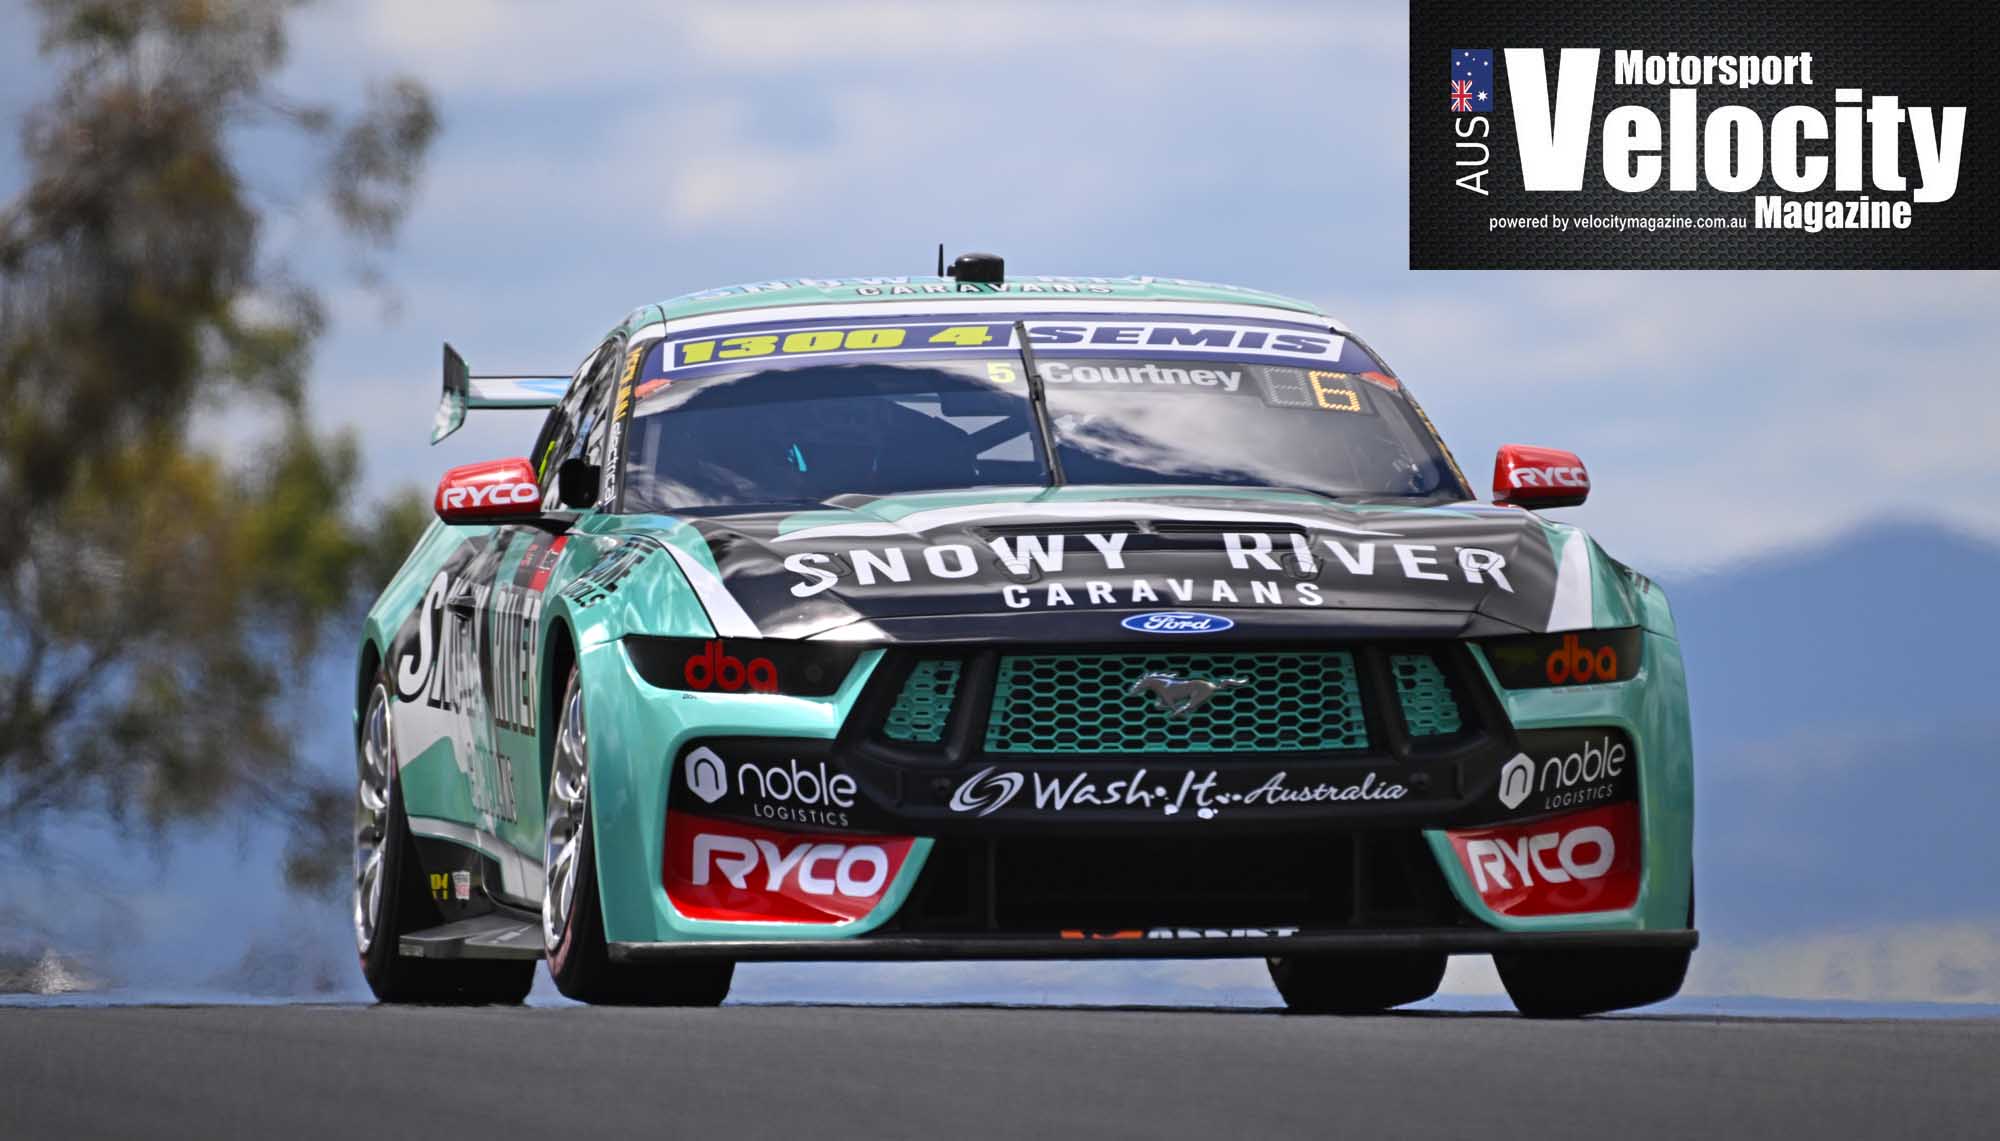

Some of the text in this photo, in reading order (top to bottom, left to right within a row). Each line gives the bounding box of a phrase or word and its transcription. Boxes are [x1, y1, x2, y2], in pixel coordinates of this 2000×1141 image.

[856, 282, 1113, 295] CARAVANS
[682, 325, 1331, 364] 1300 4 SEMIS
[988, 362, 1241, 391] 5 Courtney
[442, 482, 540, 511] RYCO
[784, 532, 1515, 597] SNOWY RIVER
[1002, 579, 1324, 609] CARAVANS
[1143, 613, 1210, 631] Ford
[684, 640, 778, 693] dba
[1546, 634, 1617, 685] dba
[1540, 736, 1627, 792] noble
[738, 759, 857, 808] noble
[1244, 771, 1408, 803] Australia
[1545, 783, 1614, 810] LOGISTICS
[754, 804, 849, 827] LOGISTICS
[692, 833, 889, 898] RYCO
[1466, 826, 1616, 894] RYCO
